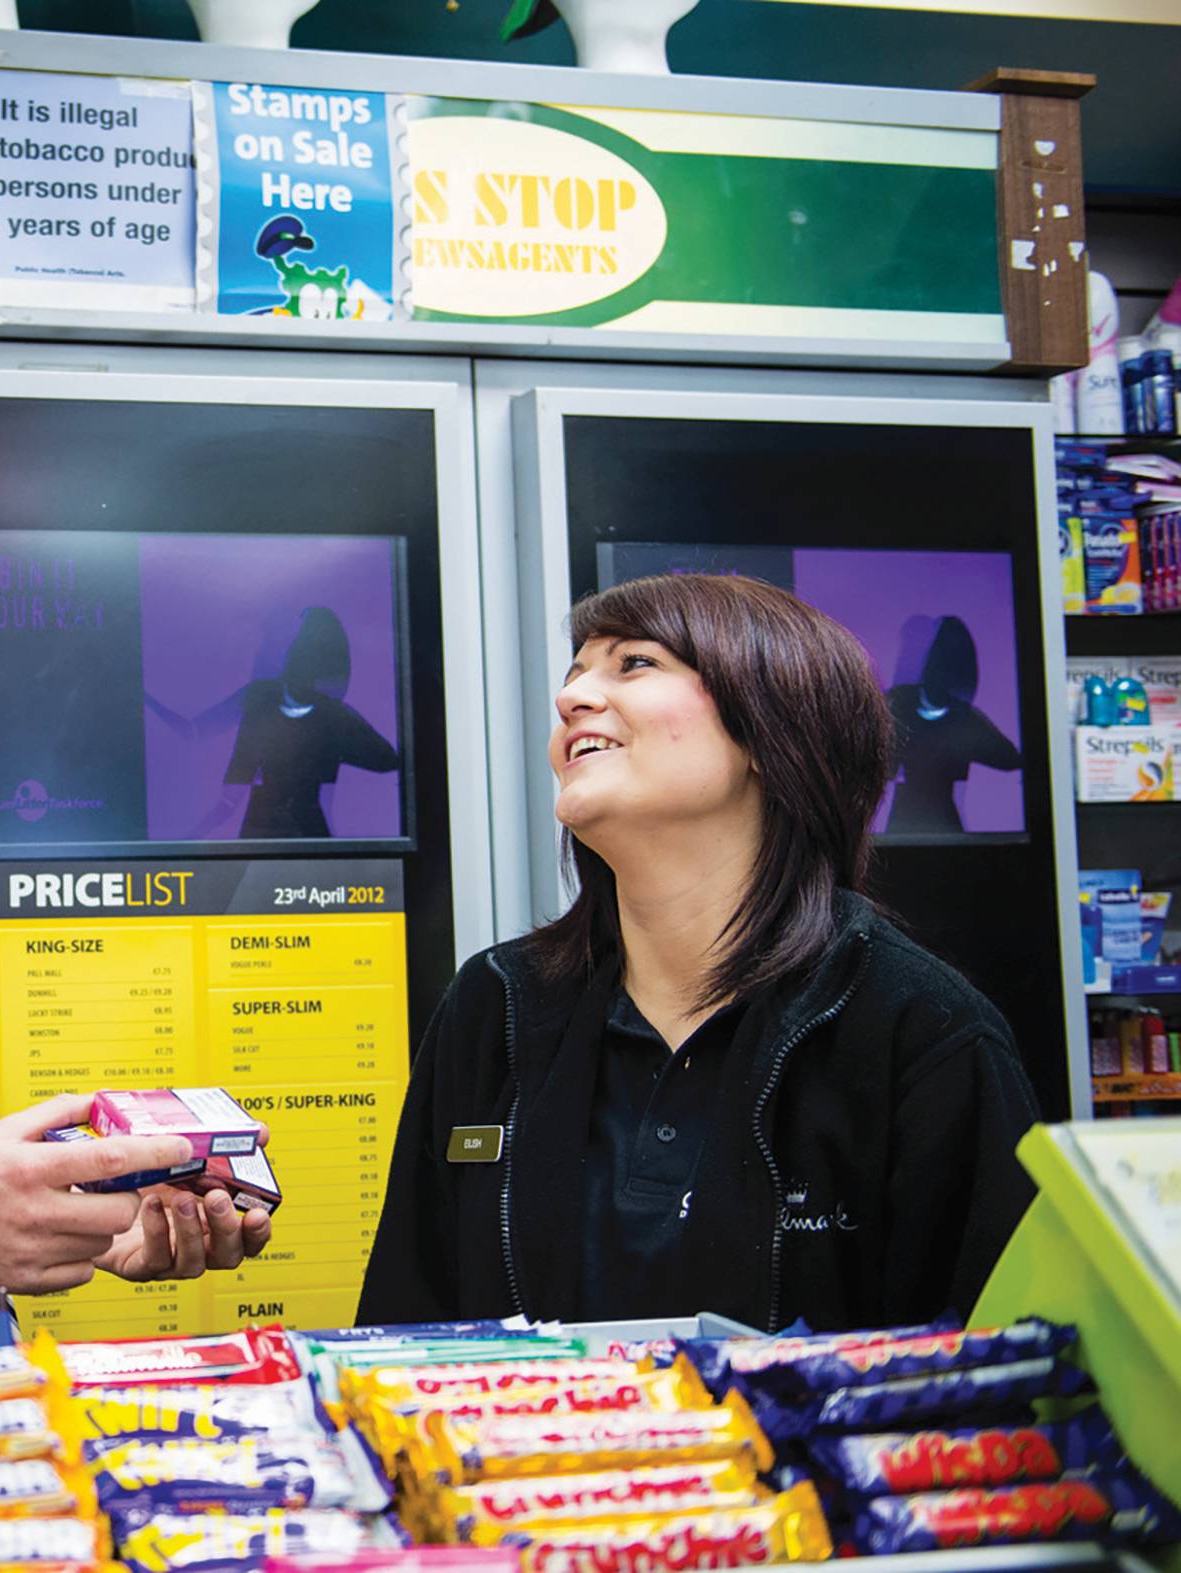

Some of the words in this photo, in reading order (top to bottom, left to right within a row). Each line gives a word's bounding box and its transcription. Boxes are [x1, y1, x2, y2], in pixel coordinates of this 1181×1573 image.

[0, 98, 20, 121] It
[27, 100, 51, 124] is
[60, 102, 139, 131] illegal
[227, 82, 372, 133] Stamps
[233, 132, 284, 162] on
[291, 130, 374, 169] Sale
[107, 181, 183, 206] under
[261, 171, 353, 213] Here
[473, 172, 638, 233] STOP
[7, 216, 81, 239] years
[89, 216, 117, 239] of
[124, 221, 172, 246] age
[413, 237, 619, 276] EWSAGENTS
[273, 885, 307, 905] 23rd
[307, 885, 346, 908] April
[347, 885, 386, 904] 2012
[25, 938, 105, 955] KING-SIZE
[230, 935, 311, 950] DEMI-SLIM
[232, 1000, 323, 1015] SUPER-SLIM
[28, 1029, 61, 1038] WINSTON
[29, 1069, 57, 1078] BENSON
[64, 1067, 91, 1077] HEDGES
[284, 1092, 377, 1110] SUPER-KING
[32, 1311, 47, 1320] SILK
[48, 1309, 61, 1318] CUT
[237, 1302, 284, 1318] PLAIN
[877, 1428, 1062, 1494] Wispa
